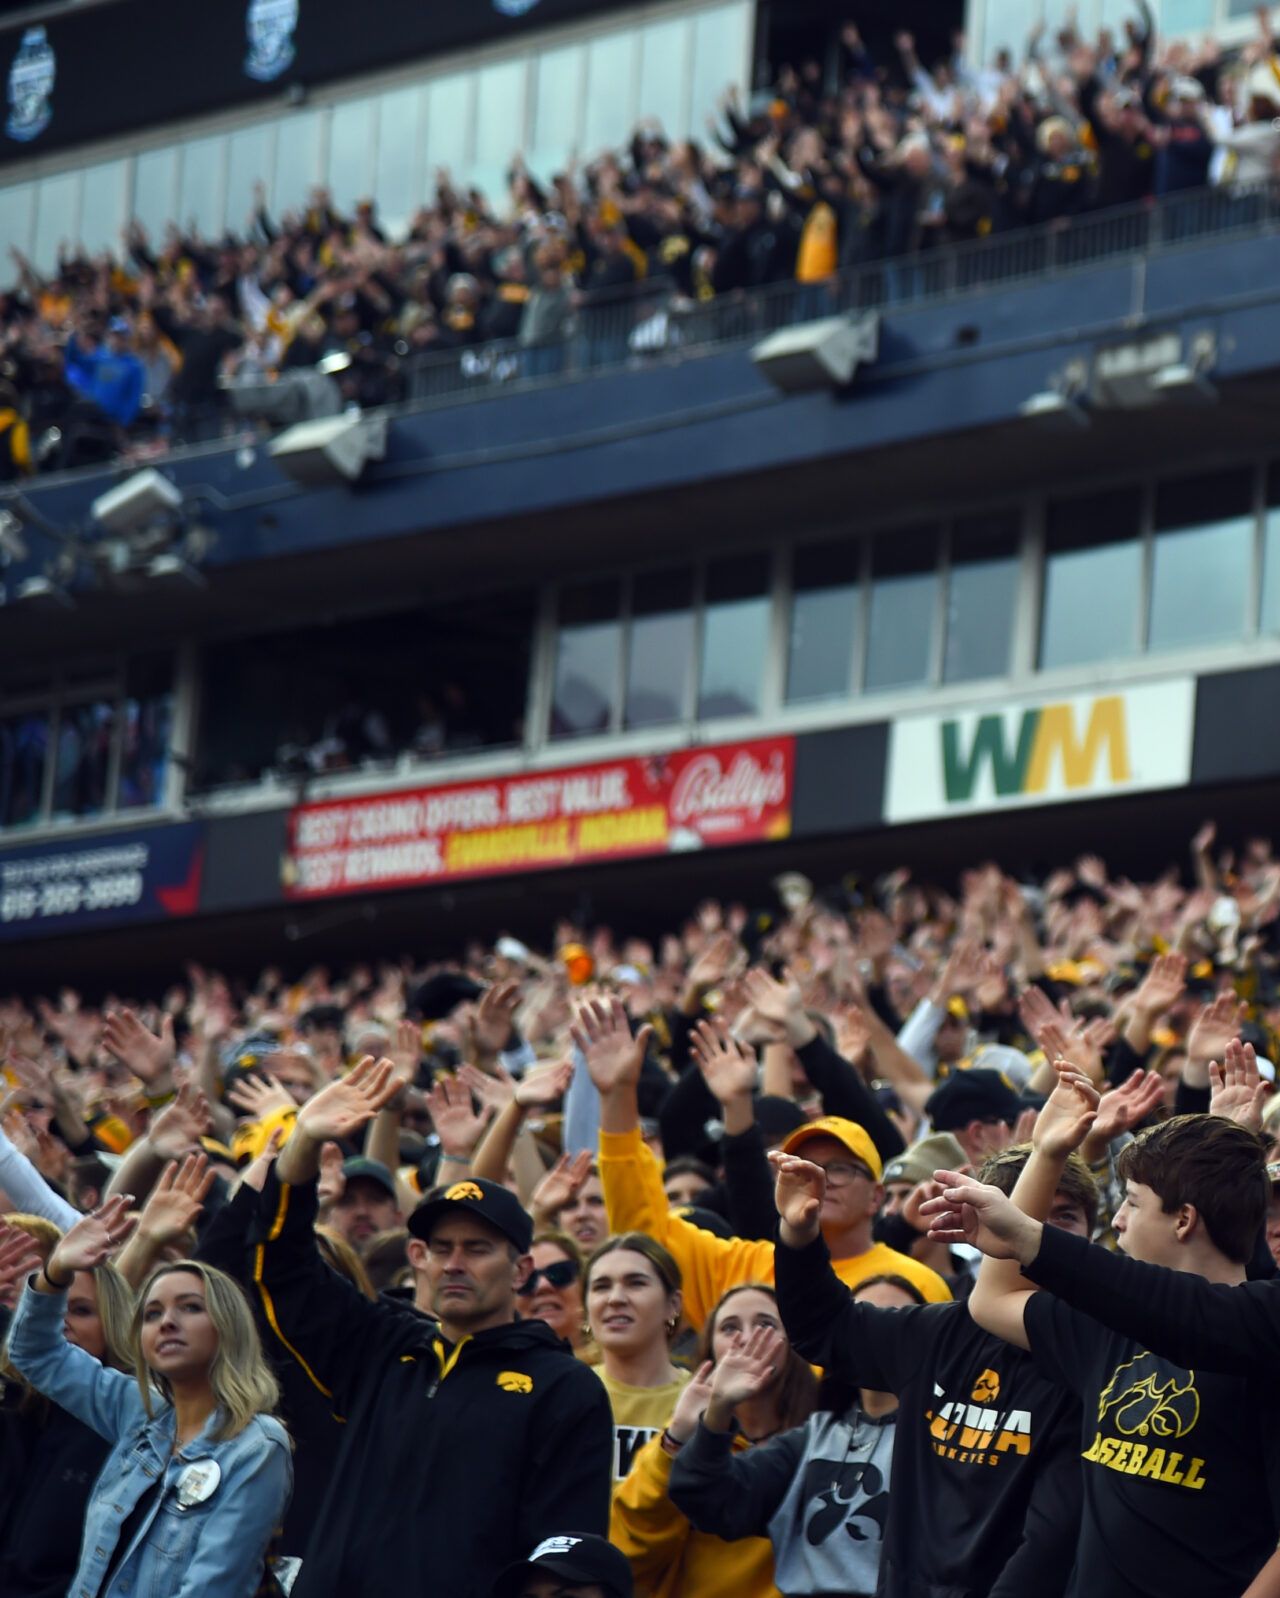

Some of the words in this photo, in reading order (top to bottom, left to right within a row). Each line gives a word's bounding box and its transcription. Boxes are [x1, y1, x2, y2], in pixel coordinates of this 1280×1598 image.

[670, 748, 786, 823] Bally's
[941, 694, 1132, 804] WM
[298, 808, 346, 849] BEST
[349, 799, 423, 842] CASINO
[505, 778, 561, 823] BEST
[925, 1381, 1032, 1456] OWA
[1081, 1432, 1207, 1490] ASEBALL
